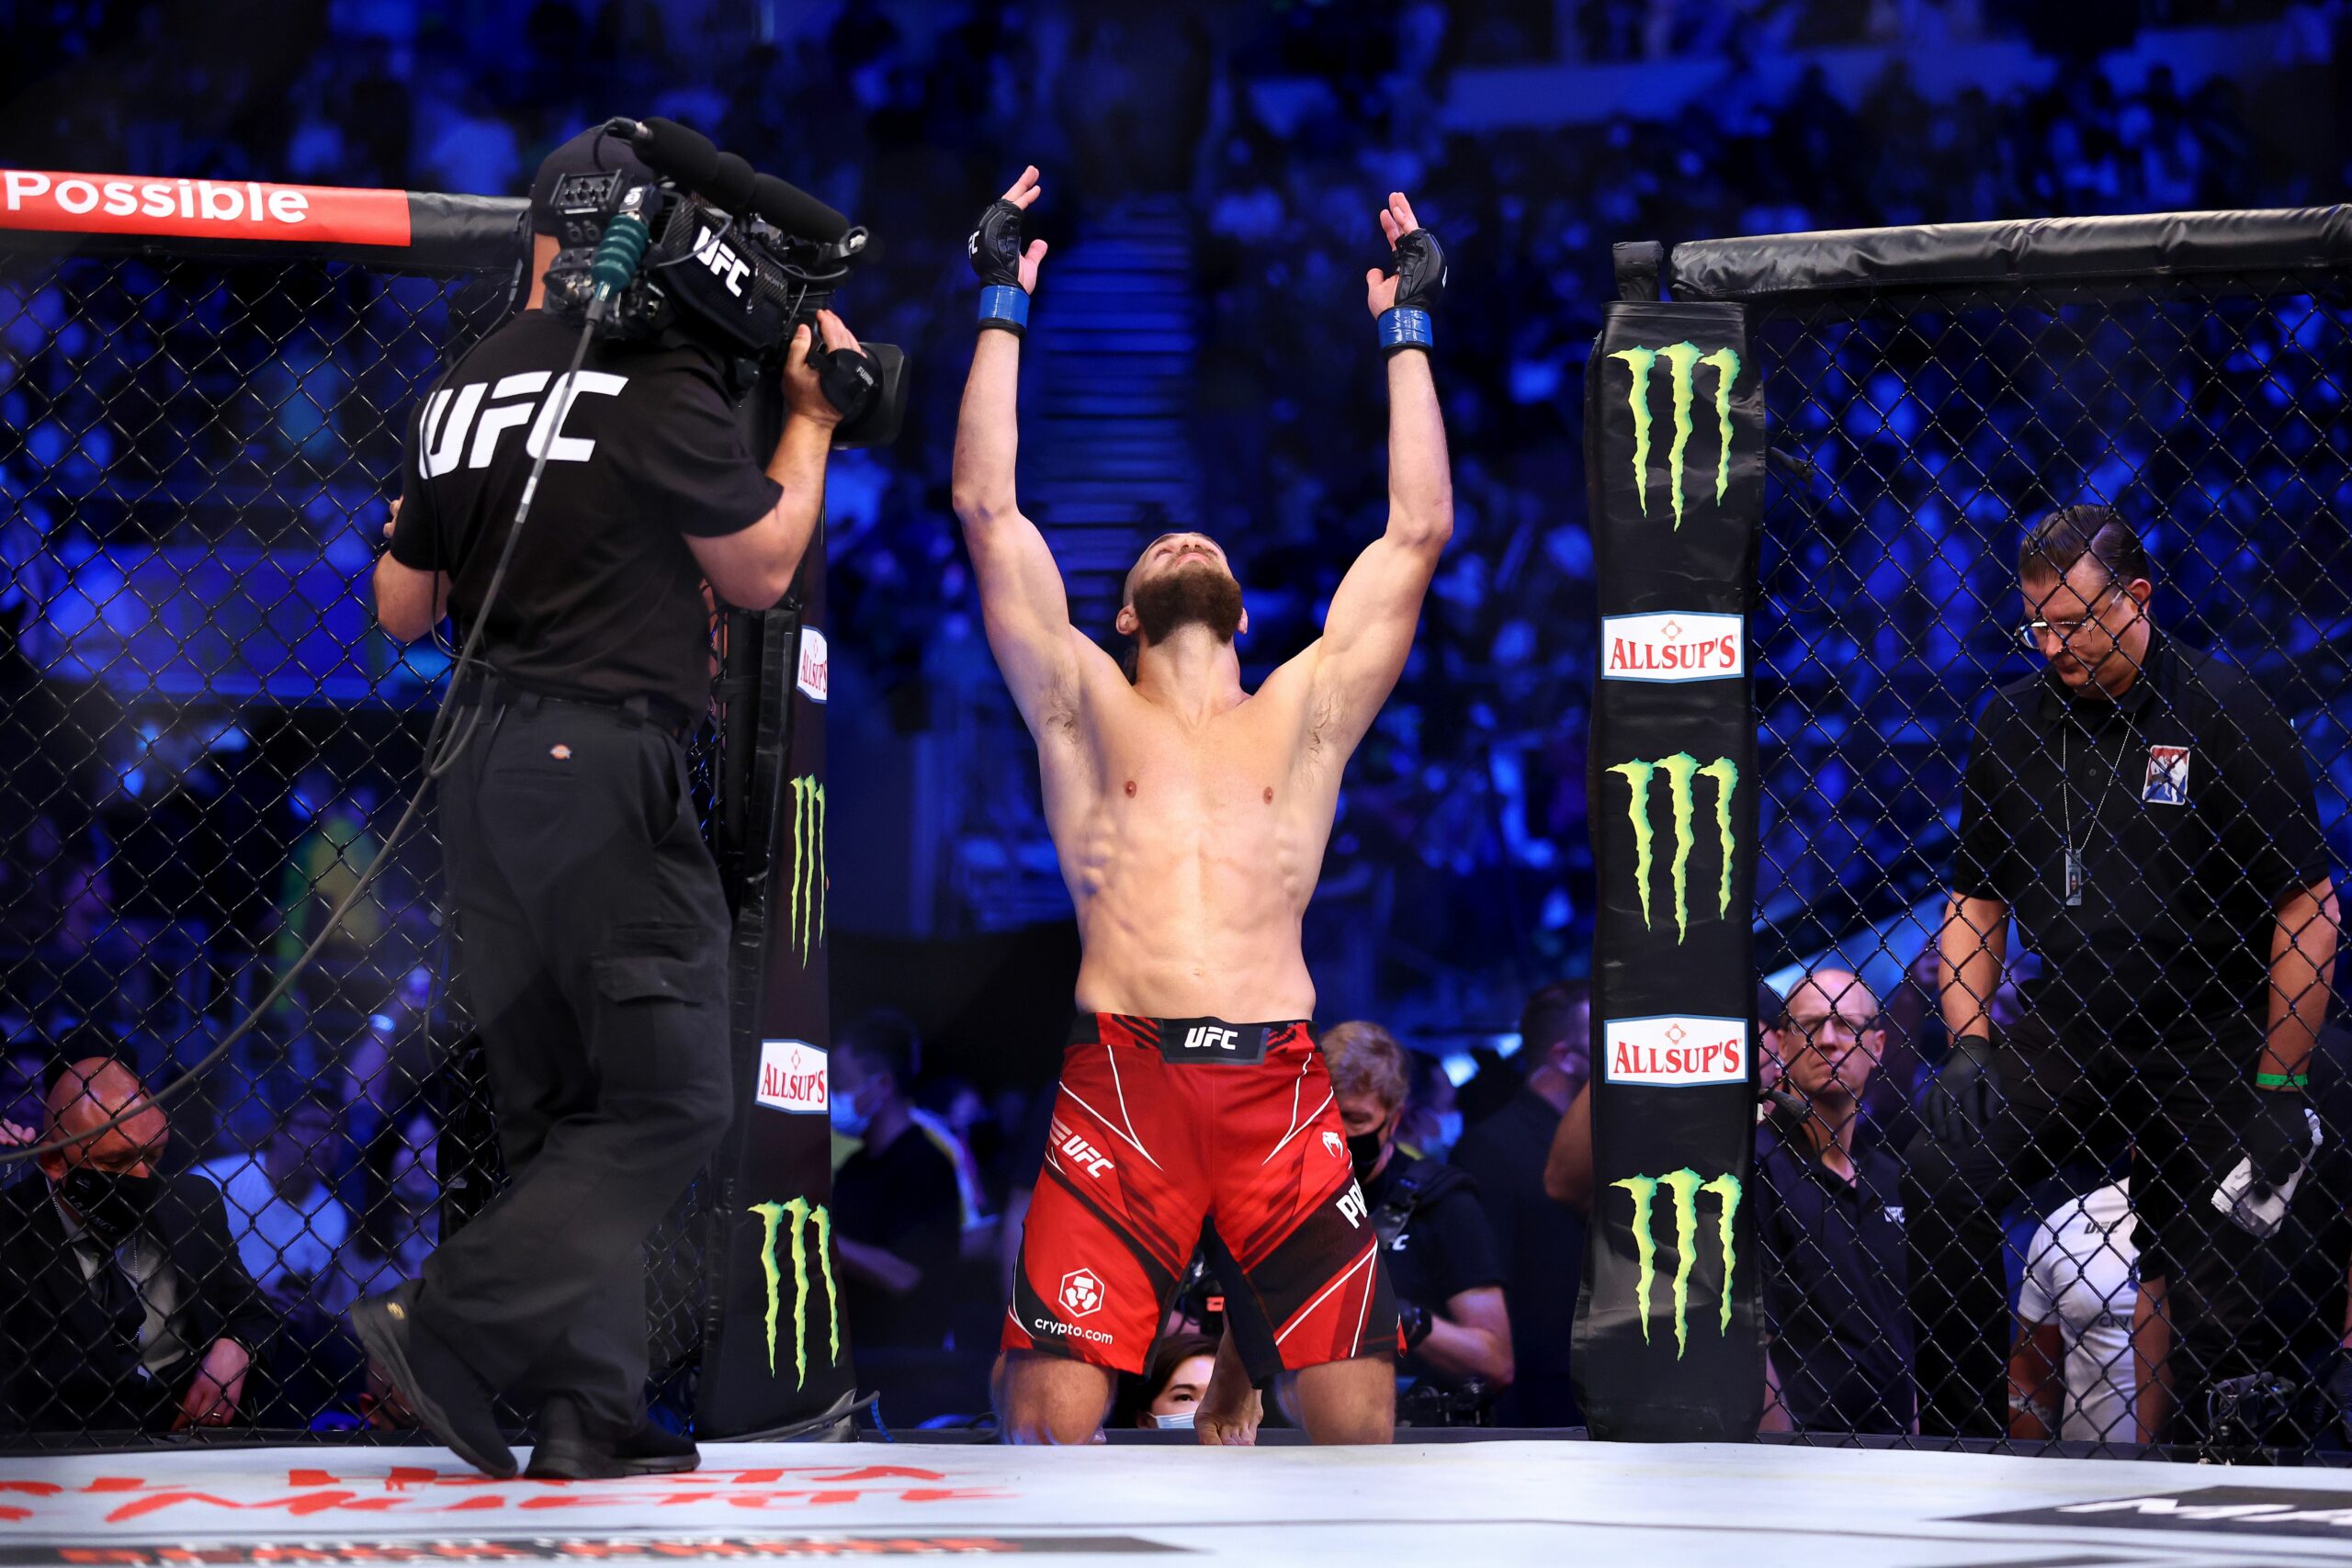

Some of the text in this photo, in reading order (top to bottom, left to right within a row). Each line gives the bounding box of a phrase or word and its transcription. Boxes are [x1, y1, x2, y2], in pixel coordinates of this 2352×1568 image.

[4, 171, 310, 223] Possible
[693, 225, 751, 298] UFC
[968, 230, 980, 259] FC
[419, 370, 629, 479] UFC
[1610, 635, 1736, 670] ALLSUP'S
[1184, 1026, 1238, 1050] UFC
[1613, 1039, 1739, 1074] ALLSUP'S
[761, 1062, 825, 1103] ALLSUP'S
[1062, 1134, 1114, 1179] UFC
[1035, 1318, 1114, 1345] crypto.com
